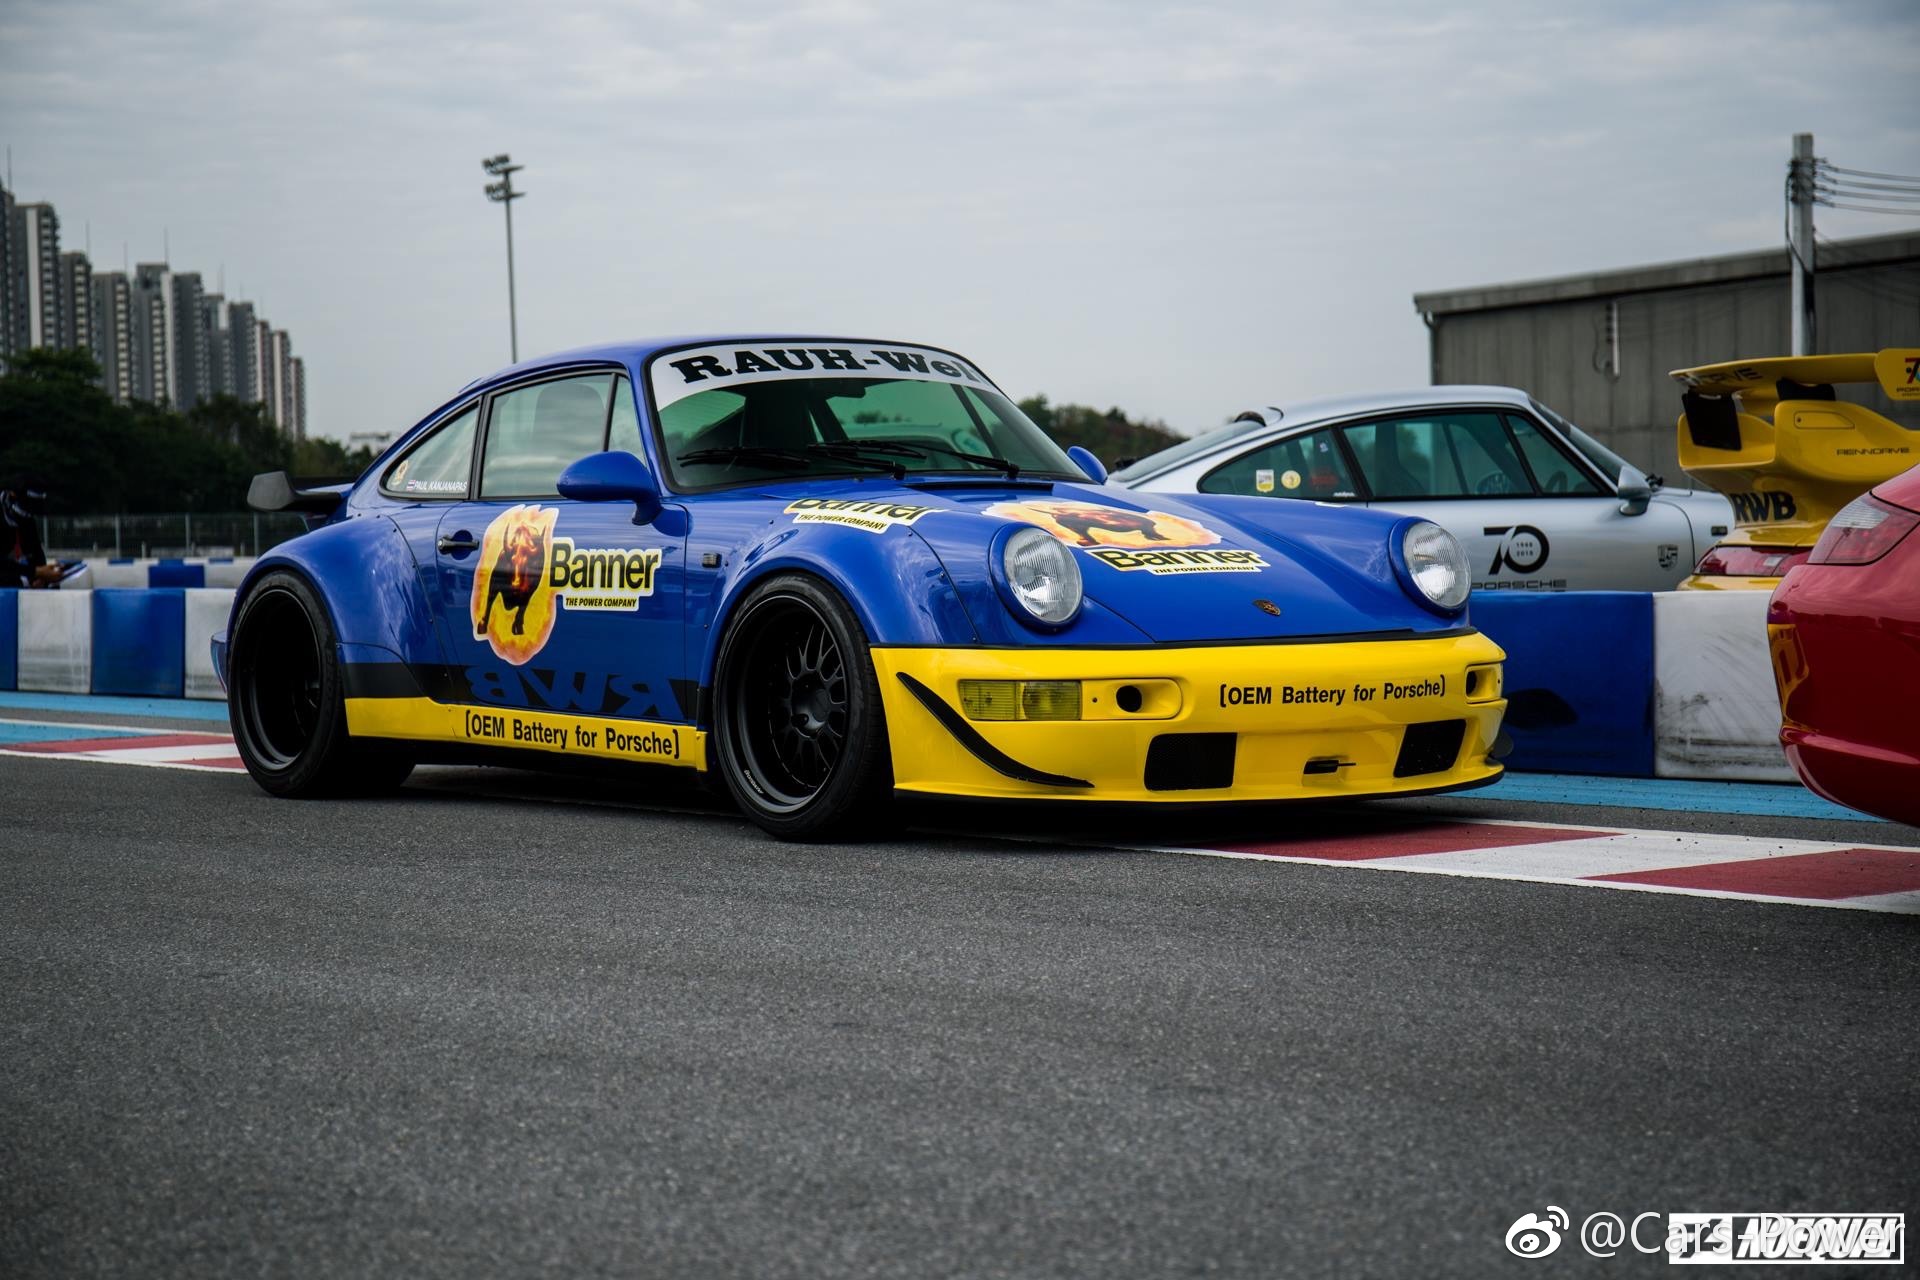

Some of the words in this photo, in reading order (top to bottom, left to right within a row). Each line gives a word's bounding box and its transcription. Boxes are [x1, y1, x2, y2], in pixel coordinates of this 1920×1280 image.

[669, 348, 981, 384] RAUH-Wel
[1729, 490, 1797, 522] RWB
[813, 514, 844, 523] POWER
[843, 517, 888, 531] COMPANY
[549, 542, 659, 590] Banner
[1091, 550, 1262, 569] Banner
[565, 597, 578, 607] THE
[578, 597, 603, 607] POWER
[603, 598, 637, 608] COMPANY
[1282, 686, 1346, 706] Battery
[1353, 684, 1376, 702] for
[513, 718, 568, 749] Battery
[575, 725, 598, 748] for
